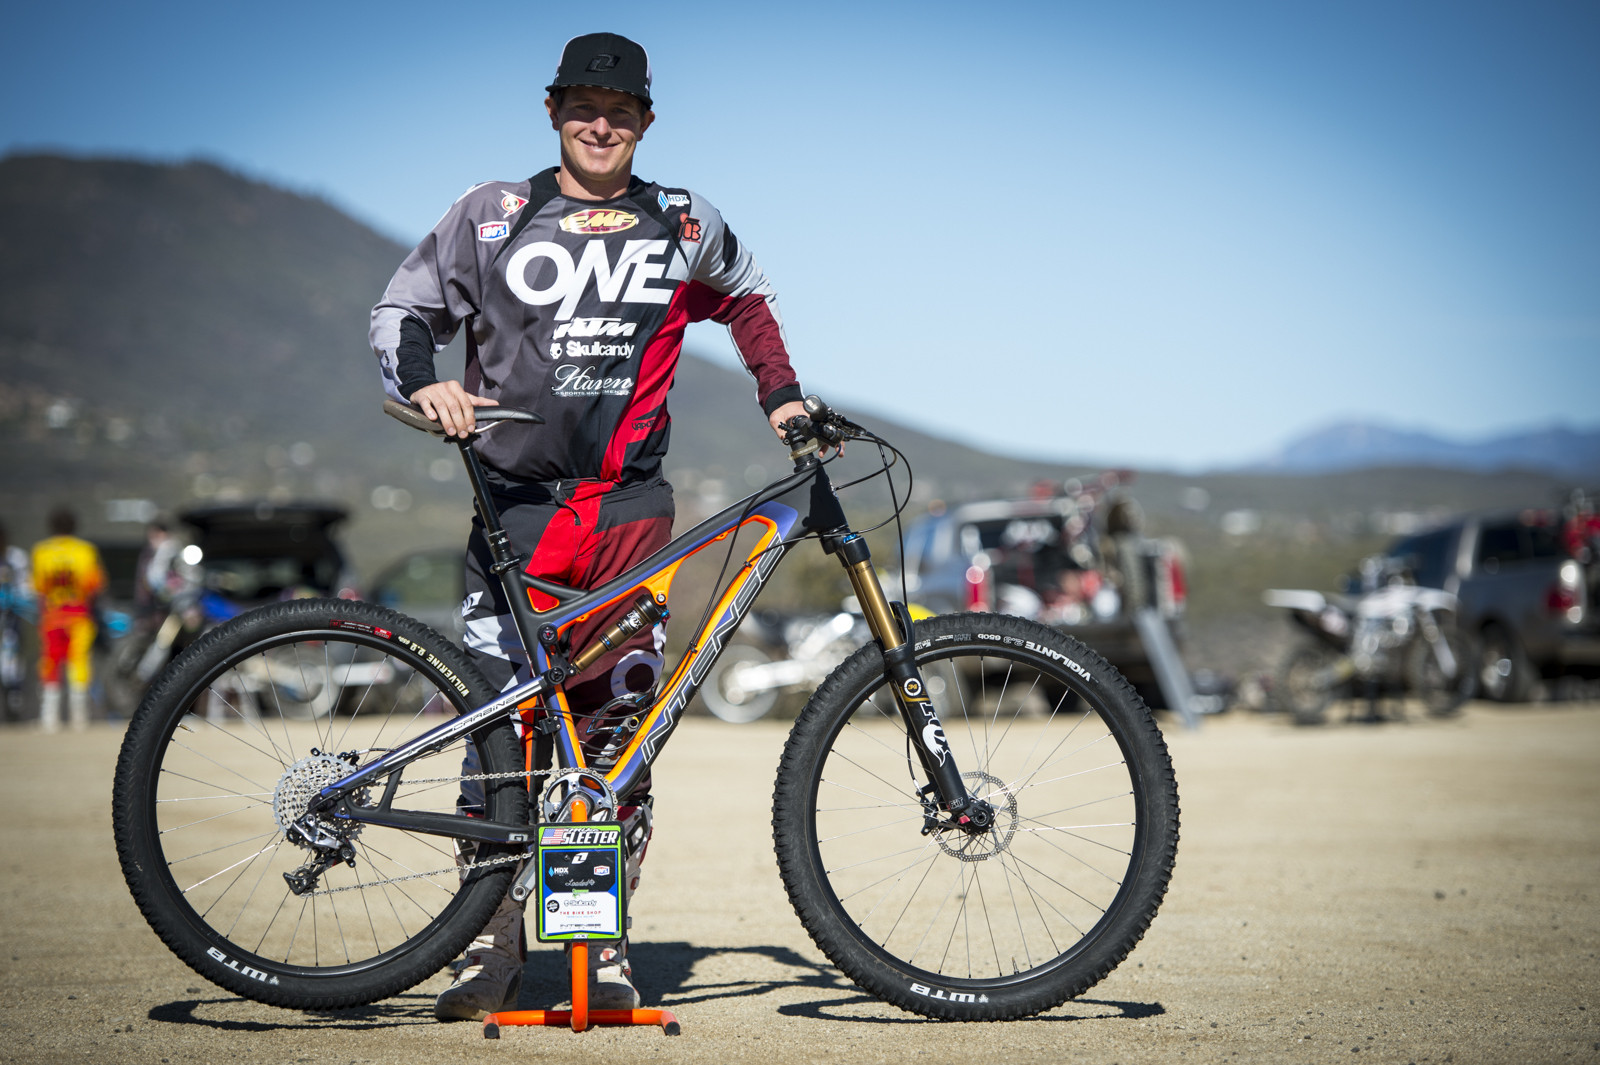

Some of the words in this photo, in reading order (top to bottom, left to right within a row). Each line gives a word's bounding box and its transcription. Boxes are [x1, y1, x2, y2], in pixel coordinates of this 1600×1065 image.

[481, 224, 507, 238] 100%
[505, 239, 676, 321] ONE
[552, 316, 638, 340] KTM
[566, 340, 635, 359] Skullcandy
[641, 532, 785, 765] INTENSE
[977, 633, 1002, 641] 650b
[426, 653, 471, 697] WOLVERINE
[1024, 640, 1092, 682] VIGILANTE
[453, 694, 517, 731] CARBINE
[560, 830, 619, 845] SLEETER
[206, 946, 268, 982] WTB
[910, 982, 975, 1003] WTB
